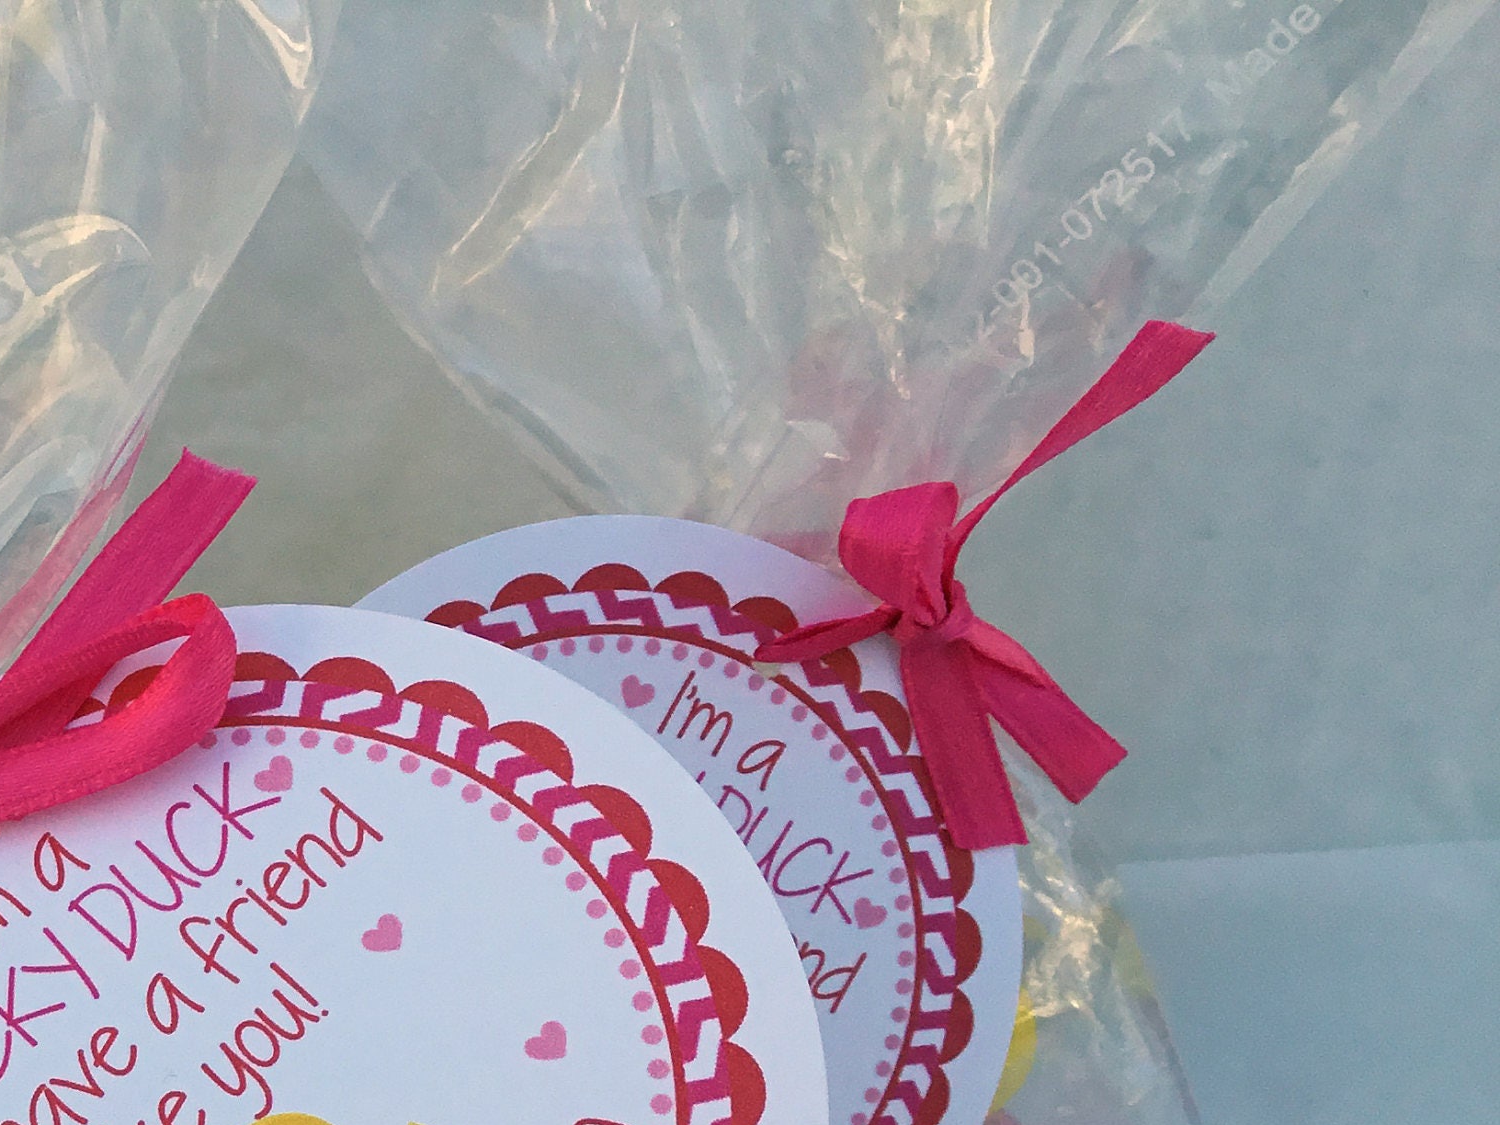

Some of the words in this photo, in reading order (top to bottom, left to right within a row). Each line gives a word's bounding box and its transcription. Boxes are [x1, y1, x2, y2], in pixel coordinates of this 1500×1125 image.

[657, 670, 734, 757] I'm
[736, 739, 787, 791] a
[34, 831, 91, 892] a
[68, 760, 282, 961] DUCK
[146, 972, 206, 1035] a
[179, 786, 385, 984] friend
[201, 962, 330, 1121] you!
